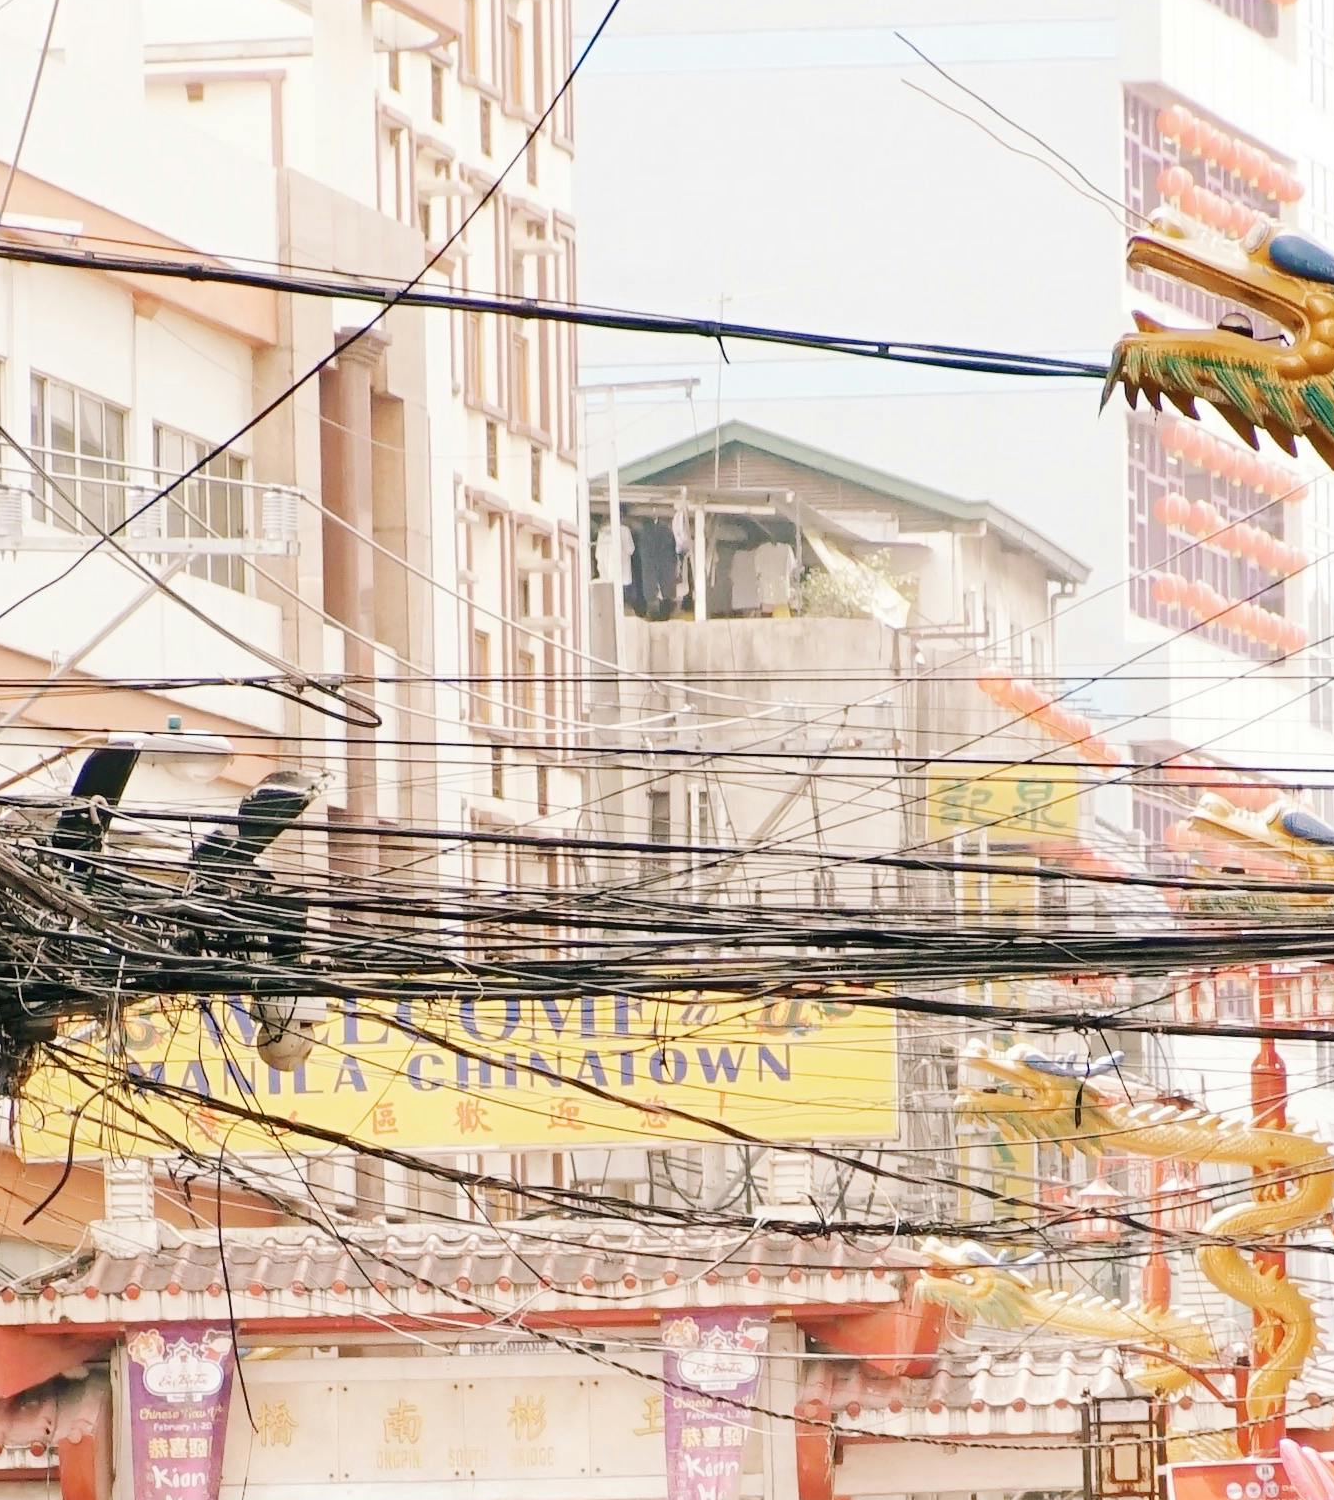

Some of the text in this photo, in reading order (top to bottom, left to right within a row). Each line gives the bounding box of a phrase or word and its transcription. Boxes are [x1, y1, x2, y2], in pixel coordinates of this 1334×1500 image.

[125, 1043, 791, 1097] MANILA CHINATOWN
[151, 1464, 206, 1490] Kian
